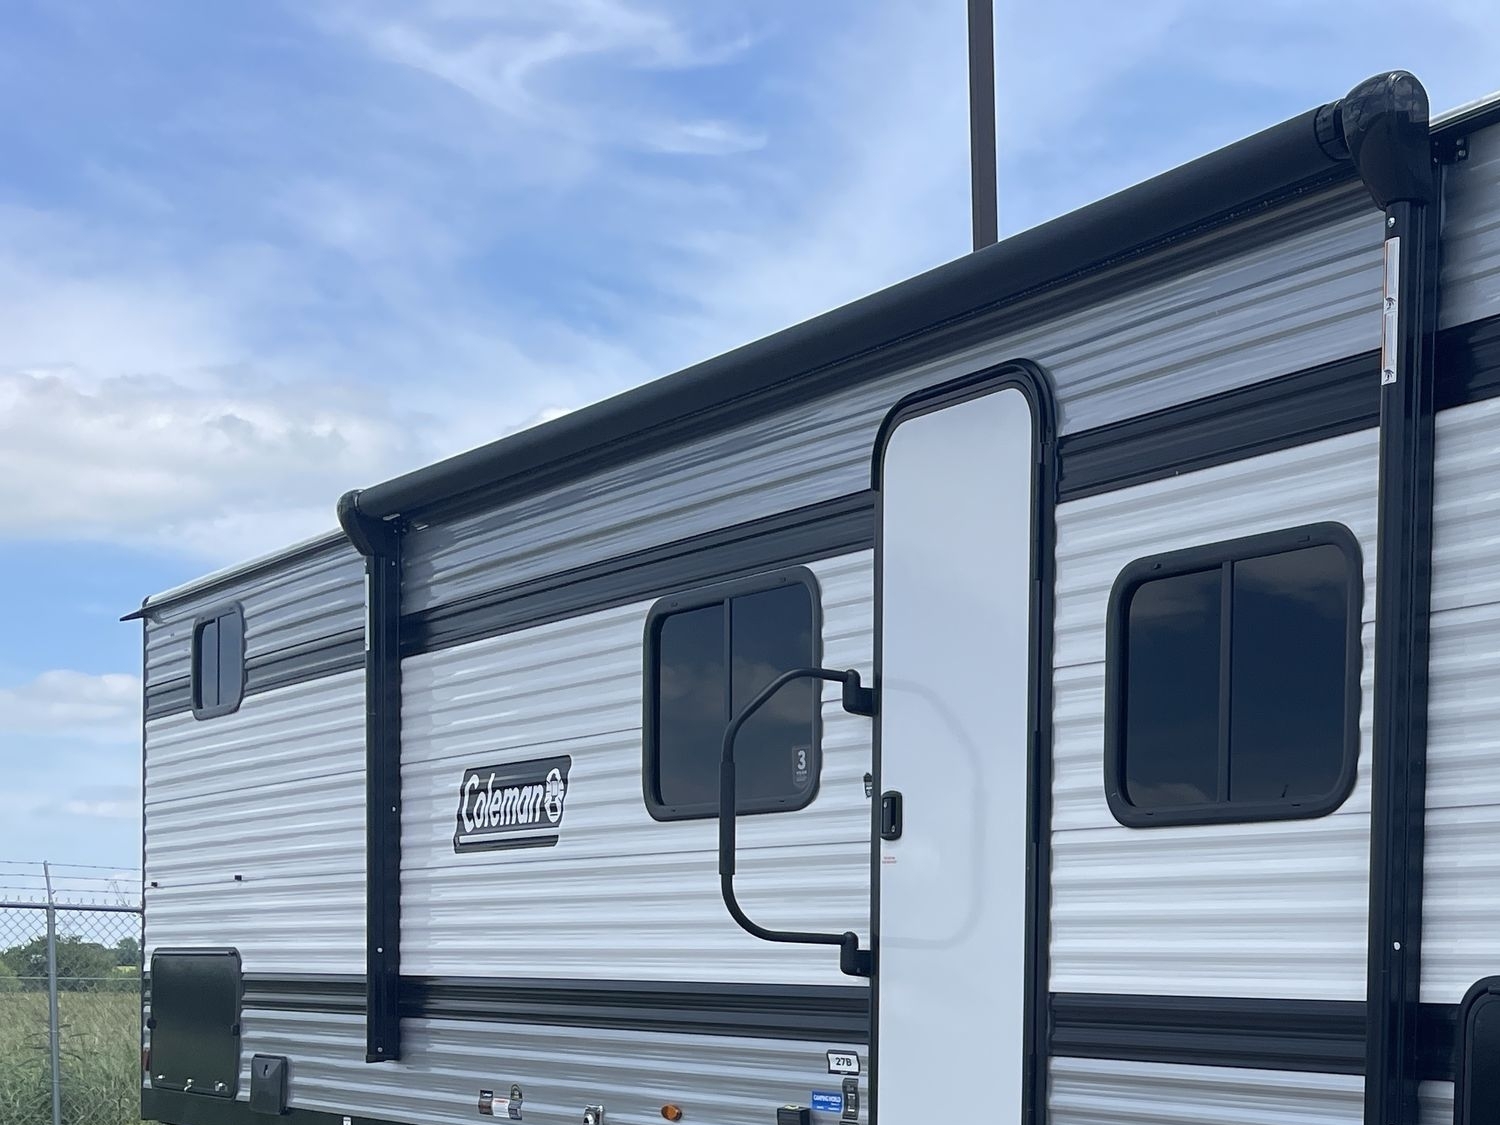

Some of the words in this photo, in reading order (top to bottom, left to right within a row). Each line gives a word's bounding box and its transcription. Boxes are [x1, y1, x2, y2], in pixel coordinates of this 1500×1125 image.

[797, 750, 806, 770] 3
[461, 772, 544, 833] Coleman
[835, 1057, 852, 1067] 27B
